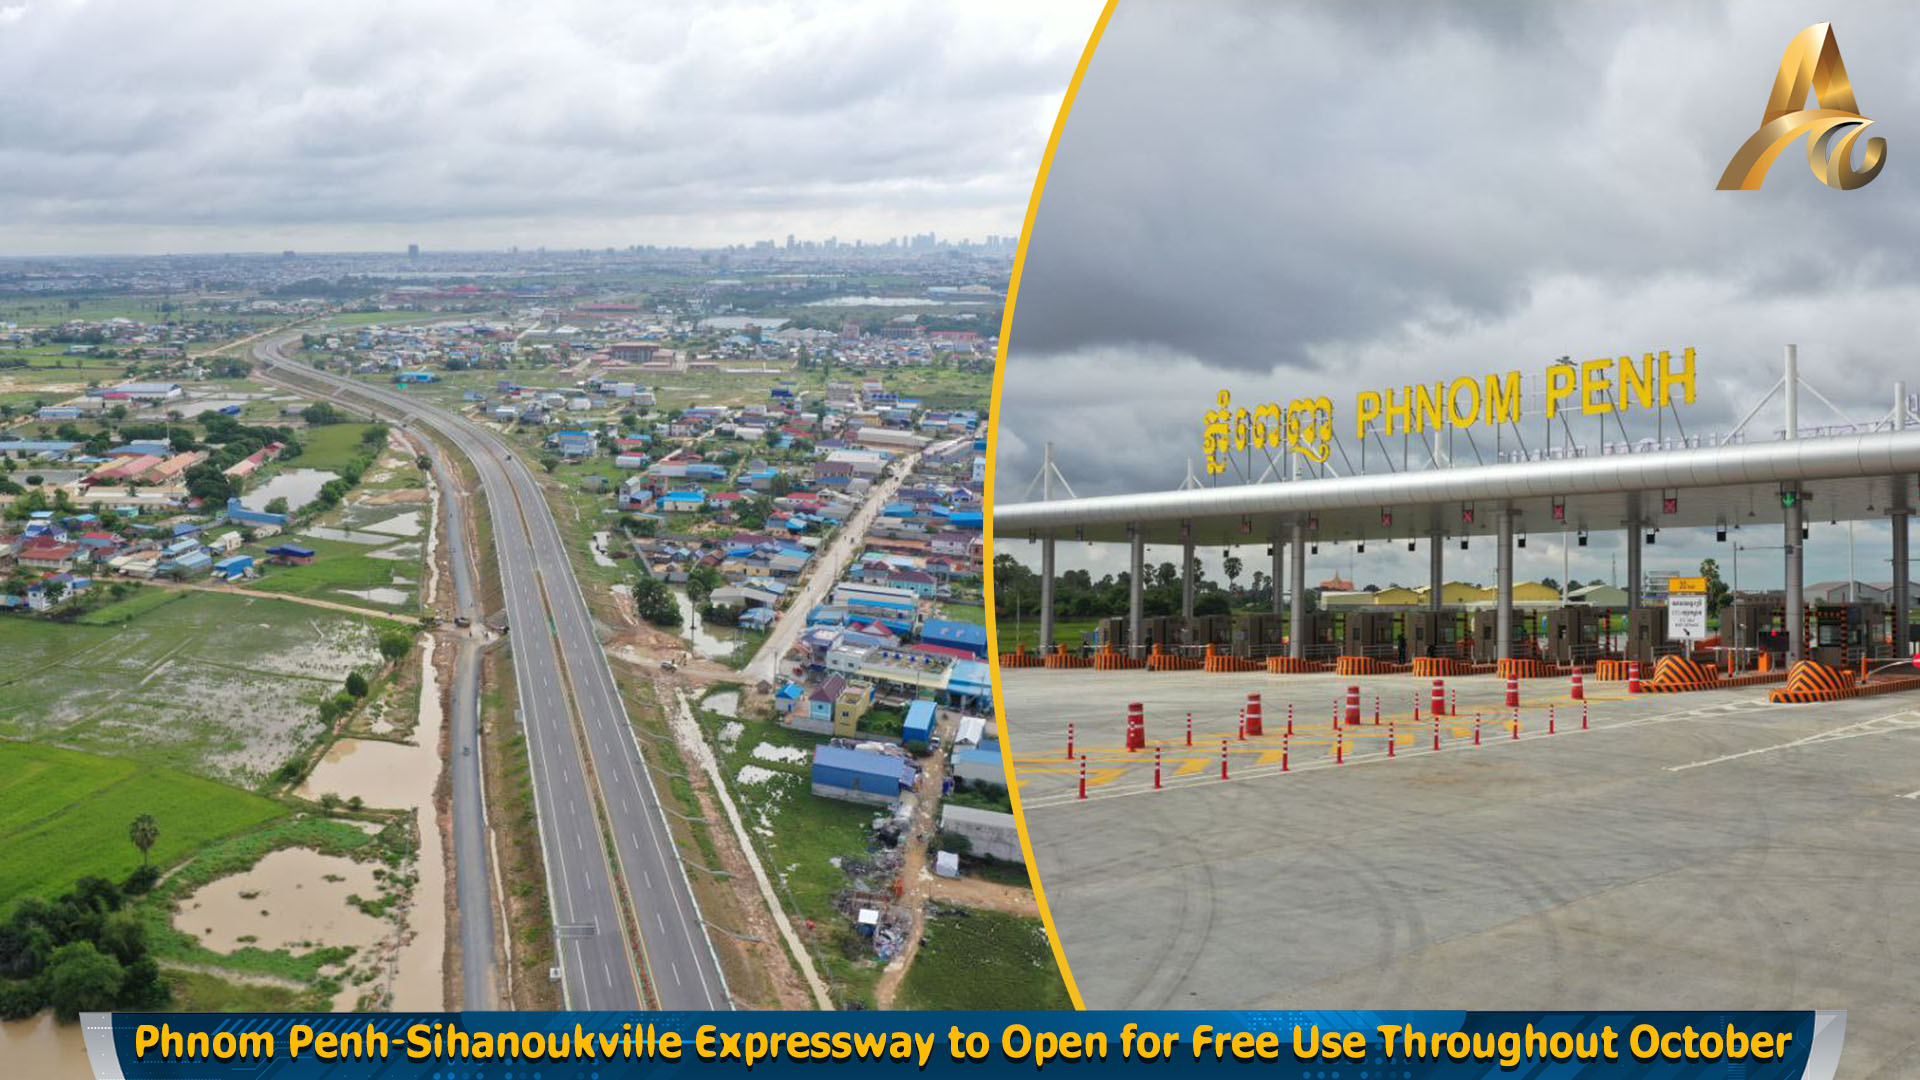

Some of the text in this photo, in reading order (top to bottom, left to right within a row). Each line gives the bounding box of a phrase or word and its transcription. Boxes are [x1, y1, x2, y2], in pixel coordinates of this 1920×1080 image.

[1202, 389, 1333, 474] ភ្នំពេញ
[1356, 347, 1696, 439] PHNOM PENH
